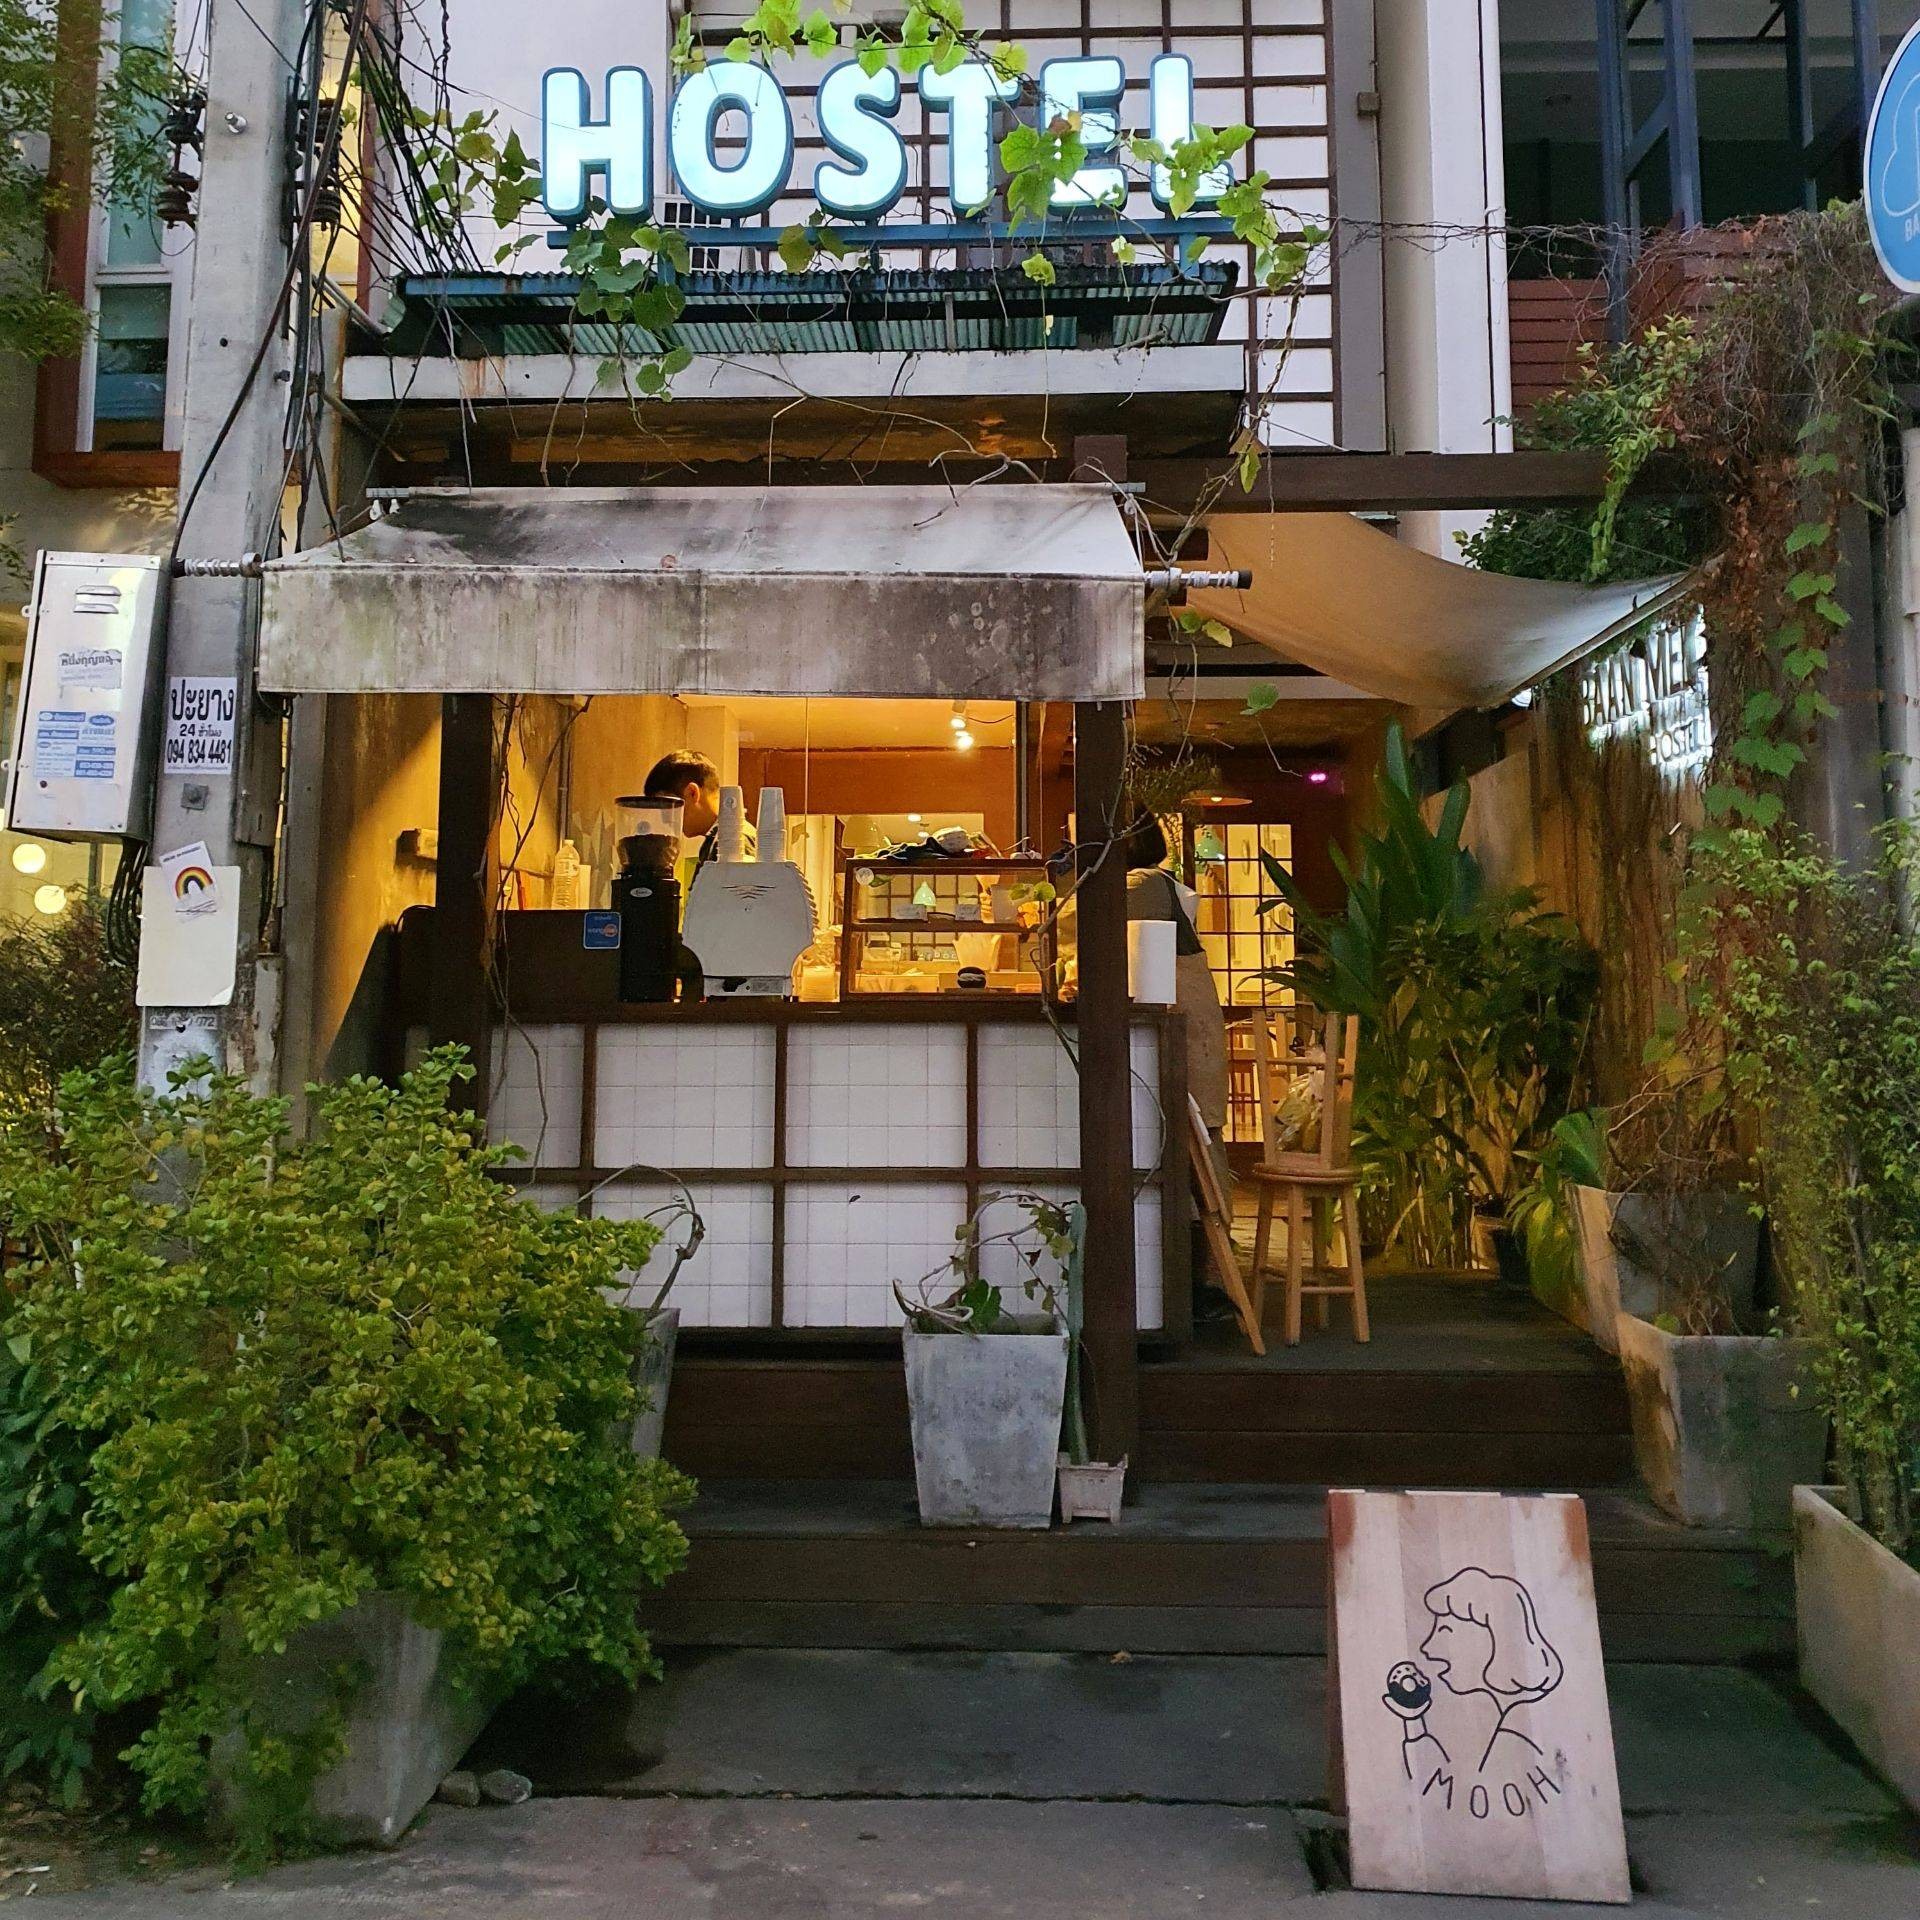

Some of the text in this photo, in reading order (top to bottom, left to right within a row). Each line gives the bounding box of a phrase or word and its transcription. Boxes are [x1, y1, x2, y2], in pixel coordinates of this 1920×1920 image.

[541, 53, 1233, 224] HOSTEL
[171, 679, 235, 721] ปะยาง
[167, 739, 232, 763] 094 834 4481
[180, 723, 196, 737] 24
[1422, 1764, 1561, 1819] MOOH
